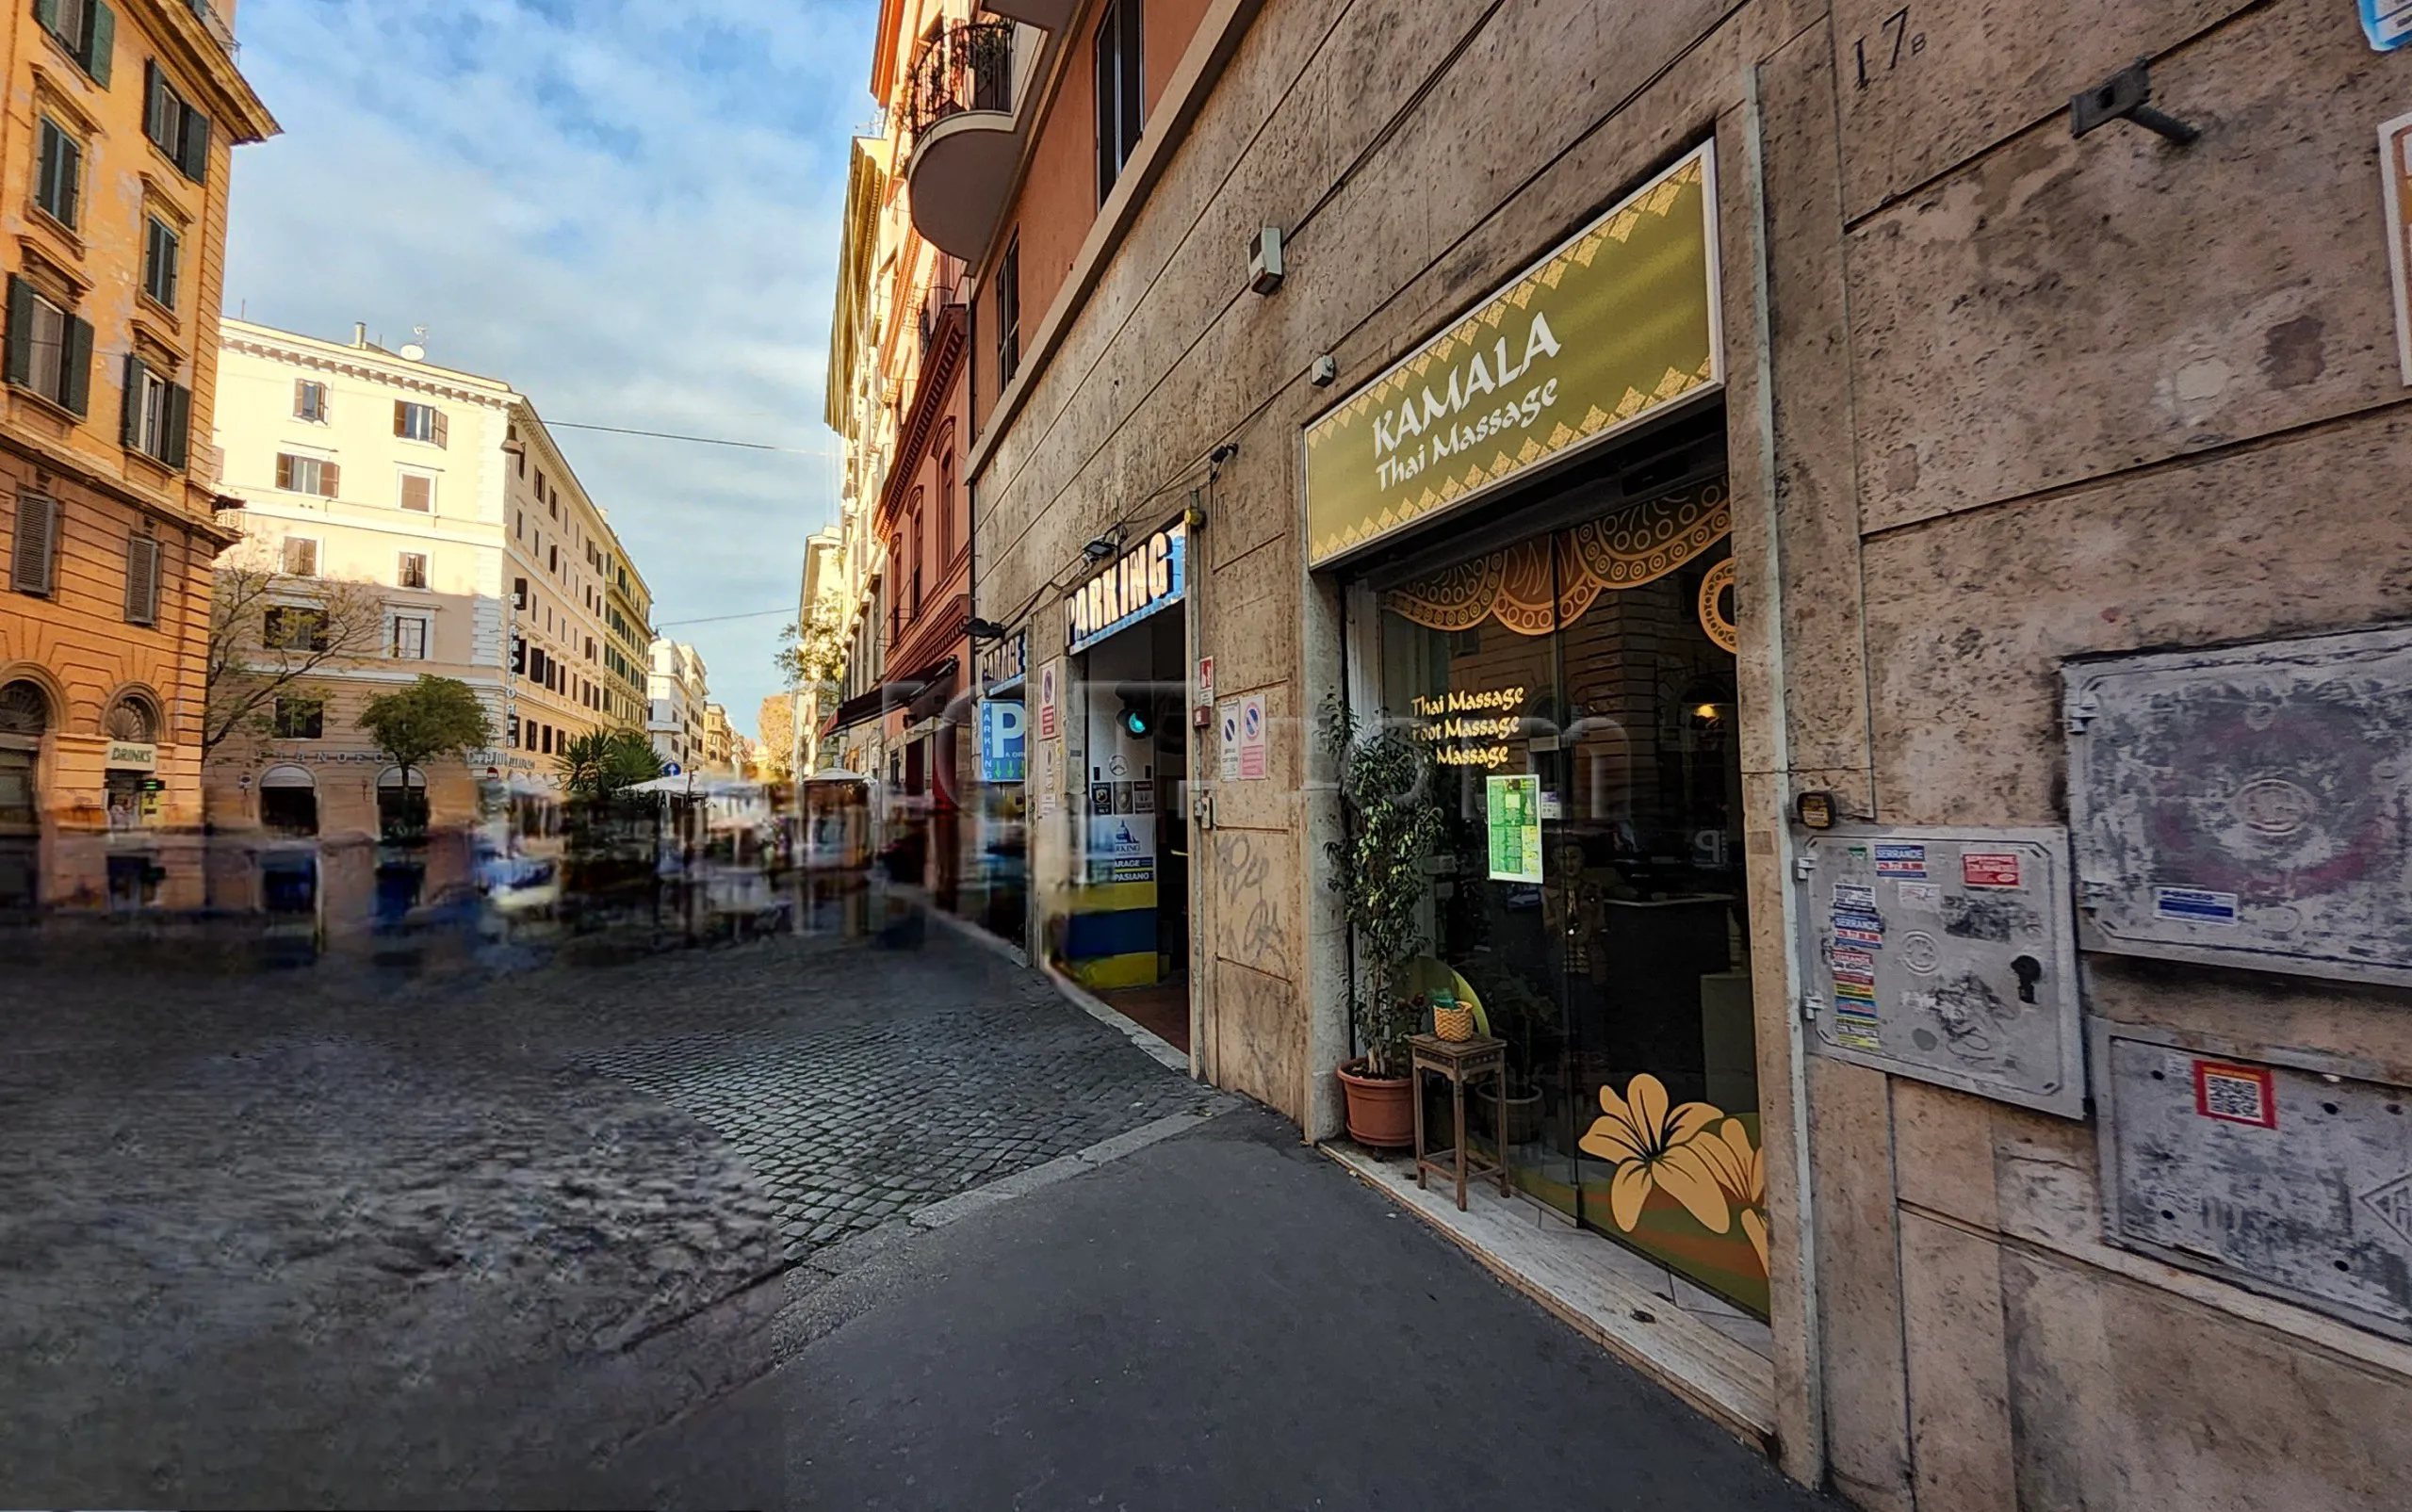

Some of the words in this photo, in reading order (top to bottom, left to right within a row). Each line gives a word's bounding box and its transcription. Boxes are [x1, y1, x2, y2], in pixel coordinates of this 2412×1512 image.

[1372, 311, 1561, 460] KAMALA
[1376, 444, 1425, 492] Thai
[1433, 378, 1557, 464] Massage
[1064, 531, 1168, 647] PARKING
[1411, 694, 1444, 716] Thai
[1448, 687, 1524, 711] Massage
[983, 703, 992, 779] PARKING
[992, 703, 1026, 758] P
[1444, 717, 1520, 740] Massage
[1436, 744, 1508, 769] Massage
[1875, 850, 1923, 859] SERRANDE
[1835, 919, 1882, 932] SERRANDE
